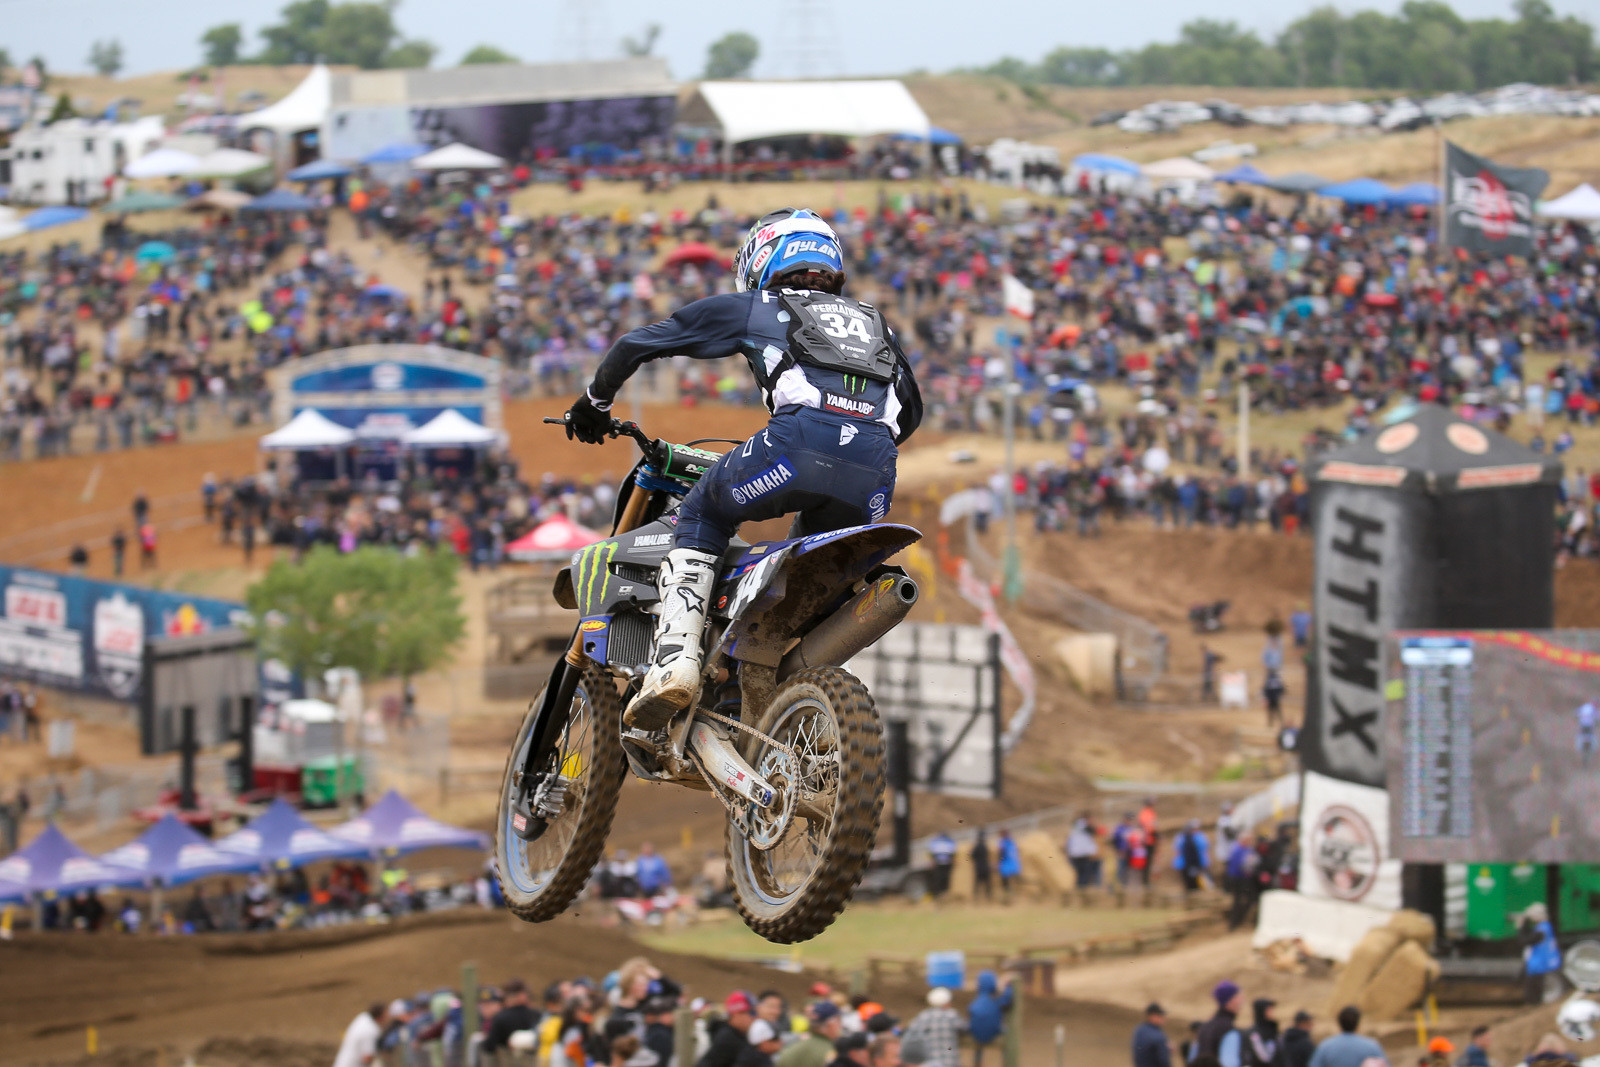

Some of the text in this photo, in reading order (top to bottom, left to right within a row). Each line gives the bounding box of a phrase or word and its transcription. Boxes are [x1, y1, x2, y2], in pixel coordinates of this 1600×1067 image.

[754, 250, 770, 269] BELL
[782, 240, 838, 260] DYLAN
[820, 313, 872, 344] 34
[742, 462, 793, 500] YAMAHA
[633, 533, 674, 546] YAMALUBE
[728, 556, 769, 619] 34
[1327, 505, 1387, 758] HTMX
